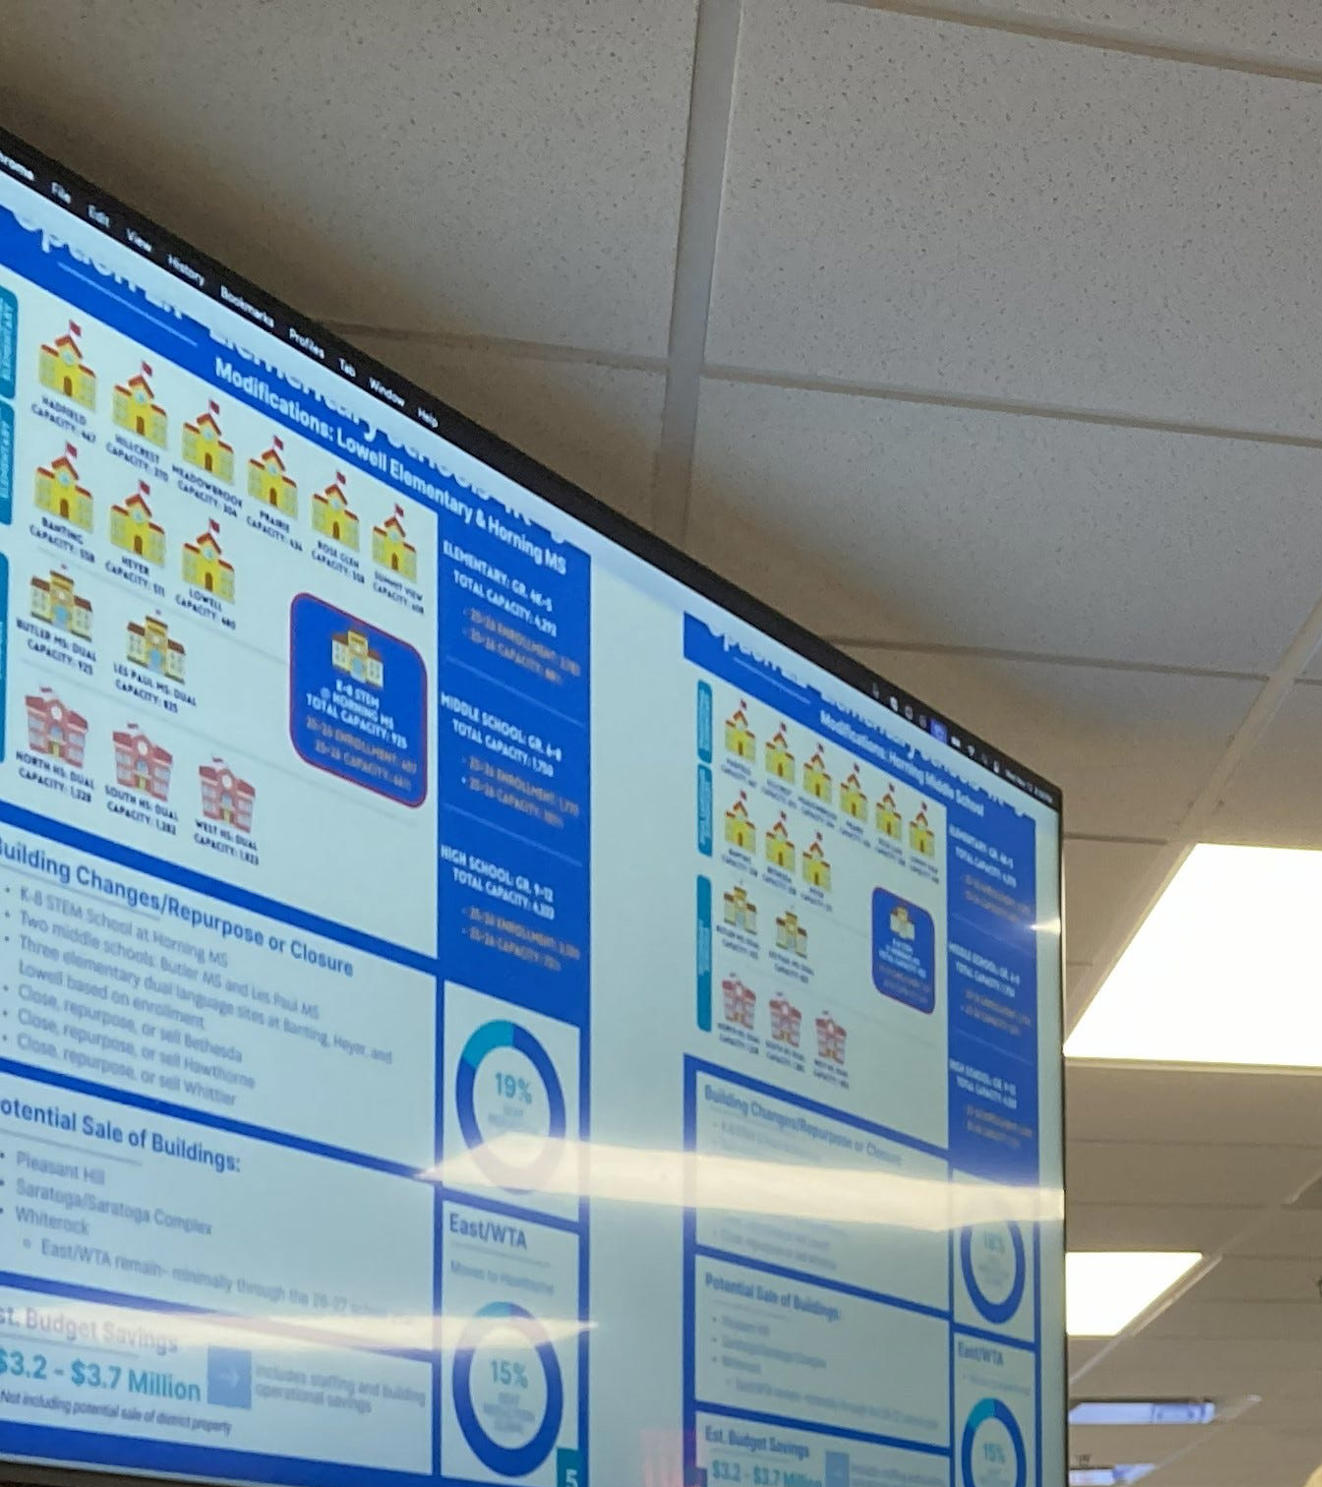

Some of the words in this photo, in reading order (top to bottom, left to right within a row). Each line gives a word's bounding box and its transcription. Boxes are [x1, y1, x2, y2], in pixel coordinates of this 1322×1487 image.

[52, 182, 71, 204] File
[88, 205, 110, 228] Edit
[126, 228, 152, 252] View
[168, 255, 205, 286] History
[221, 286, 275, 328] Bookmarks
[289, 328, 325, 359] Profiles
[338, 357, 357, 378] Tab
[369, 378, 405, 407] Window
[417, 407, 439, 428] Help
[215, 357, 334, 441] Modifications:
[337, 427, 387, 472] Lowell
[390, 457, 473, 524] Elementary
[476, 509, 486, 530] &
[488, 515, 543, 565] Horning
[544, 549, 567, 575] MS
[188, 587, 222, 612] LOWELL
[453, 569, 486, 599] TOTAL
[131, 669, 154, 691] PAUL
[306, 693, 339, 720] TOTAL
[355, 687, 380, 708] STEM
[440, 692, 480, 721] MIDDLE
[380, 712, 394, 731] MS
[452, 718, 482, 744] TOTAL
[15, 750, 51, 773] NORTH
[105, 784, 137, 805] SOUTH
[195, 818, 218, 836] WEST
[440, 844, 466, 866] HIGH
[452, 867, 483, 892] TOTAL
[47, 894, 82, 918] STEM
[87, 908, 132, 936] School
[136, 927, 149, 941] at
[153, 931, 205, 964] Horning
[209, 949, 228, 968] MS
[76, 865, 264, 947] Changes/Repurpose
[268, 936, 287, 953] or
[291, 940, 353, 978] Closure
[20, 910, 48, 934] Two
[52, 922, 100, 949] middle
[160, 957, 198, 980] Butler
[202, 971, 221, 989] MS
[225, 980, 248, 997] and
[252, 986, 272, 1003] Les
[274, 992, 298, 1012] Paul
[301, 1003, 319, 1020] MS
[19, 959, 63, 986] Lowell
[67, 975, 107, 1000] based
[133, 999, 205, 1029] enrollment
[19, 934, 59, 962] Three
[63, 951, 140, 989] elementary
[144, 976, 172, 997] dual
[177, 985, 233, 1017] language
[371, 1049, 392, 1065] and
[142, 1023, 155, 1037] or
[184, 1033, 242, 1063] Bethesda
[141, 1048, 155, 1062] or
[184, 1058, 255, 1089] Hawthorne
[141, 1072, 155, 1085] or
[184, 1080, 237, 1106] Whittier
[495, 1071, 533, 1105] 19%
[0, 1098, 76, 1132] otential
[82, 1115, 123, 1142] Sale
[128, 1128, 147, 1149] of
[152, 1132, 241, 1174] Buildings:
[17, 1150, 79, 1179] Pleasant
[84, 1167, 105, 1185] Hill
[15, 1206, 89, 1235] Whiterock
[16, 1178, 150, 1224] Saratoga/Saratoga
[154, 1208, 213, 1236] Complex
[449, 1212, 527, 1250] East/WTA
[41, 1238, 111, 1266] East/WTA
[0, 1306, 20, 1327] st.
[26, 1307, 97, 1341] Budget
[102, 1320, 179, 1357] Savings
[0, 1347, 47, 1380] $3.2
[71, 1357, 122, 1388] $3.7
[128, 1369, 202, 1402] Million
[490, 1359, 529, 1389] 15%
